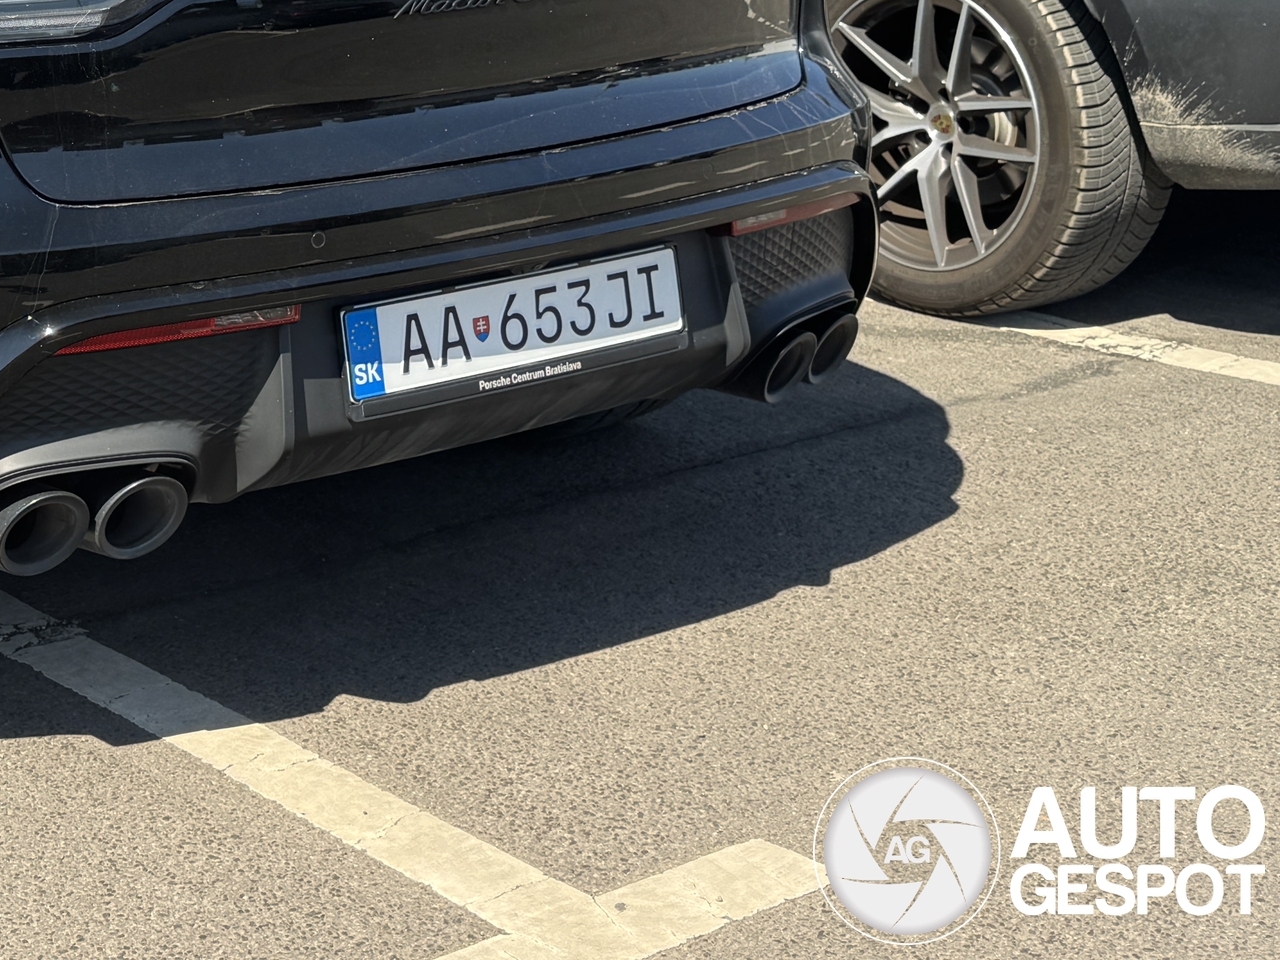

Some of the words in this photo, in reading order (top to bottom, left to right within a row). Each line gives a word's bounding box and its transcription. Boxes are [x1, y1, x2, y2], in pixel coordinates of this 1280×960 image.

[402, 305, 472, 375] AA
[354, 361, 382, 386] SK
[479, 376, 511, 391] Porsche
[511, 368, 545, 384] Centrum
[545, 361, 582, 376] Bratislava
